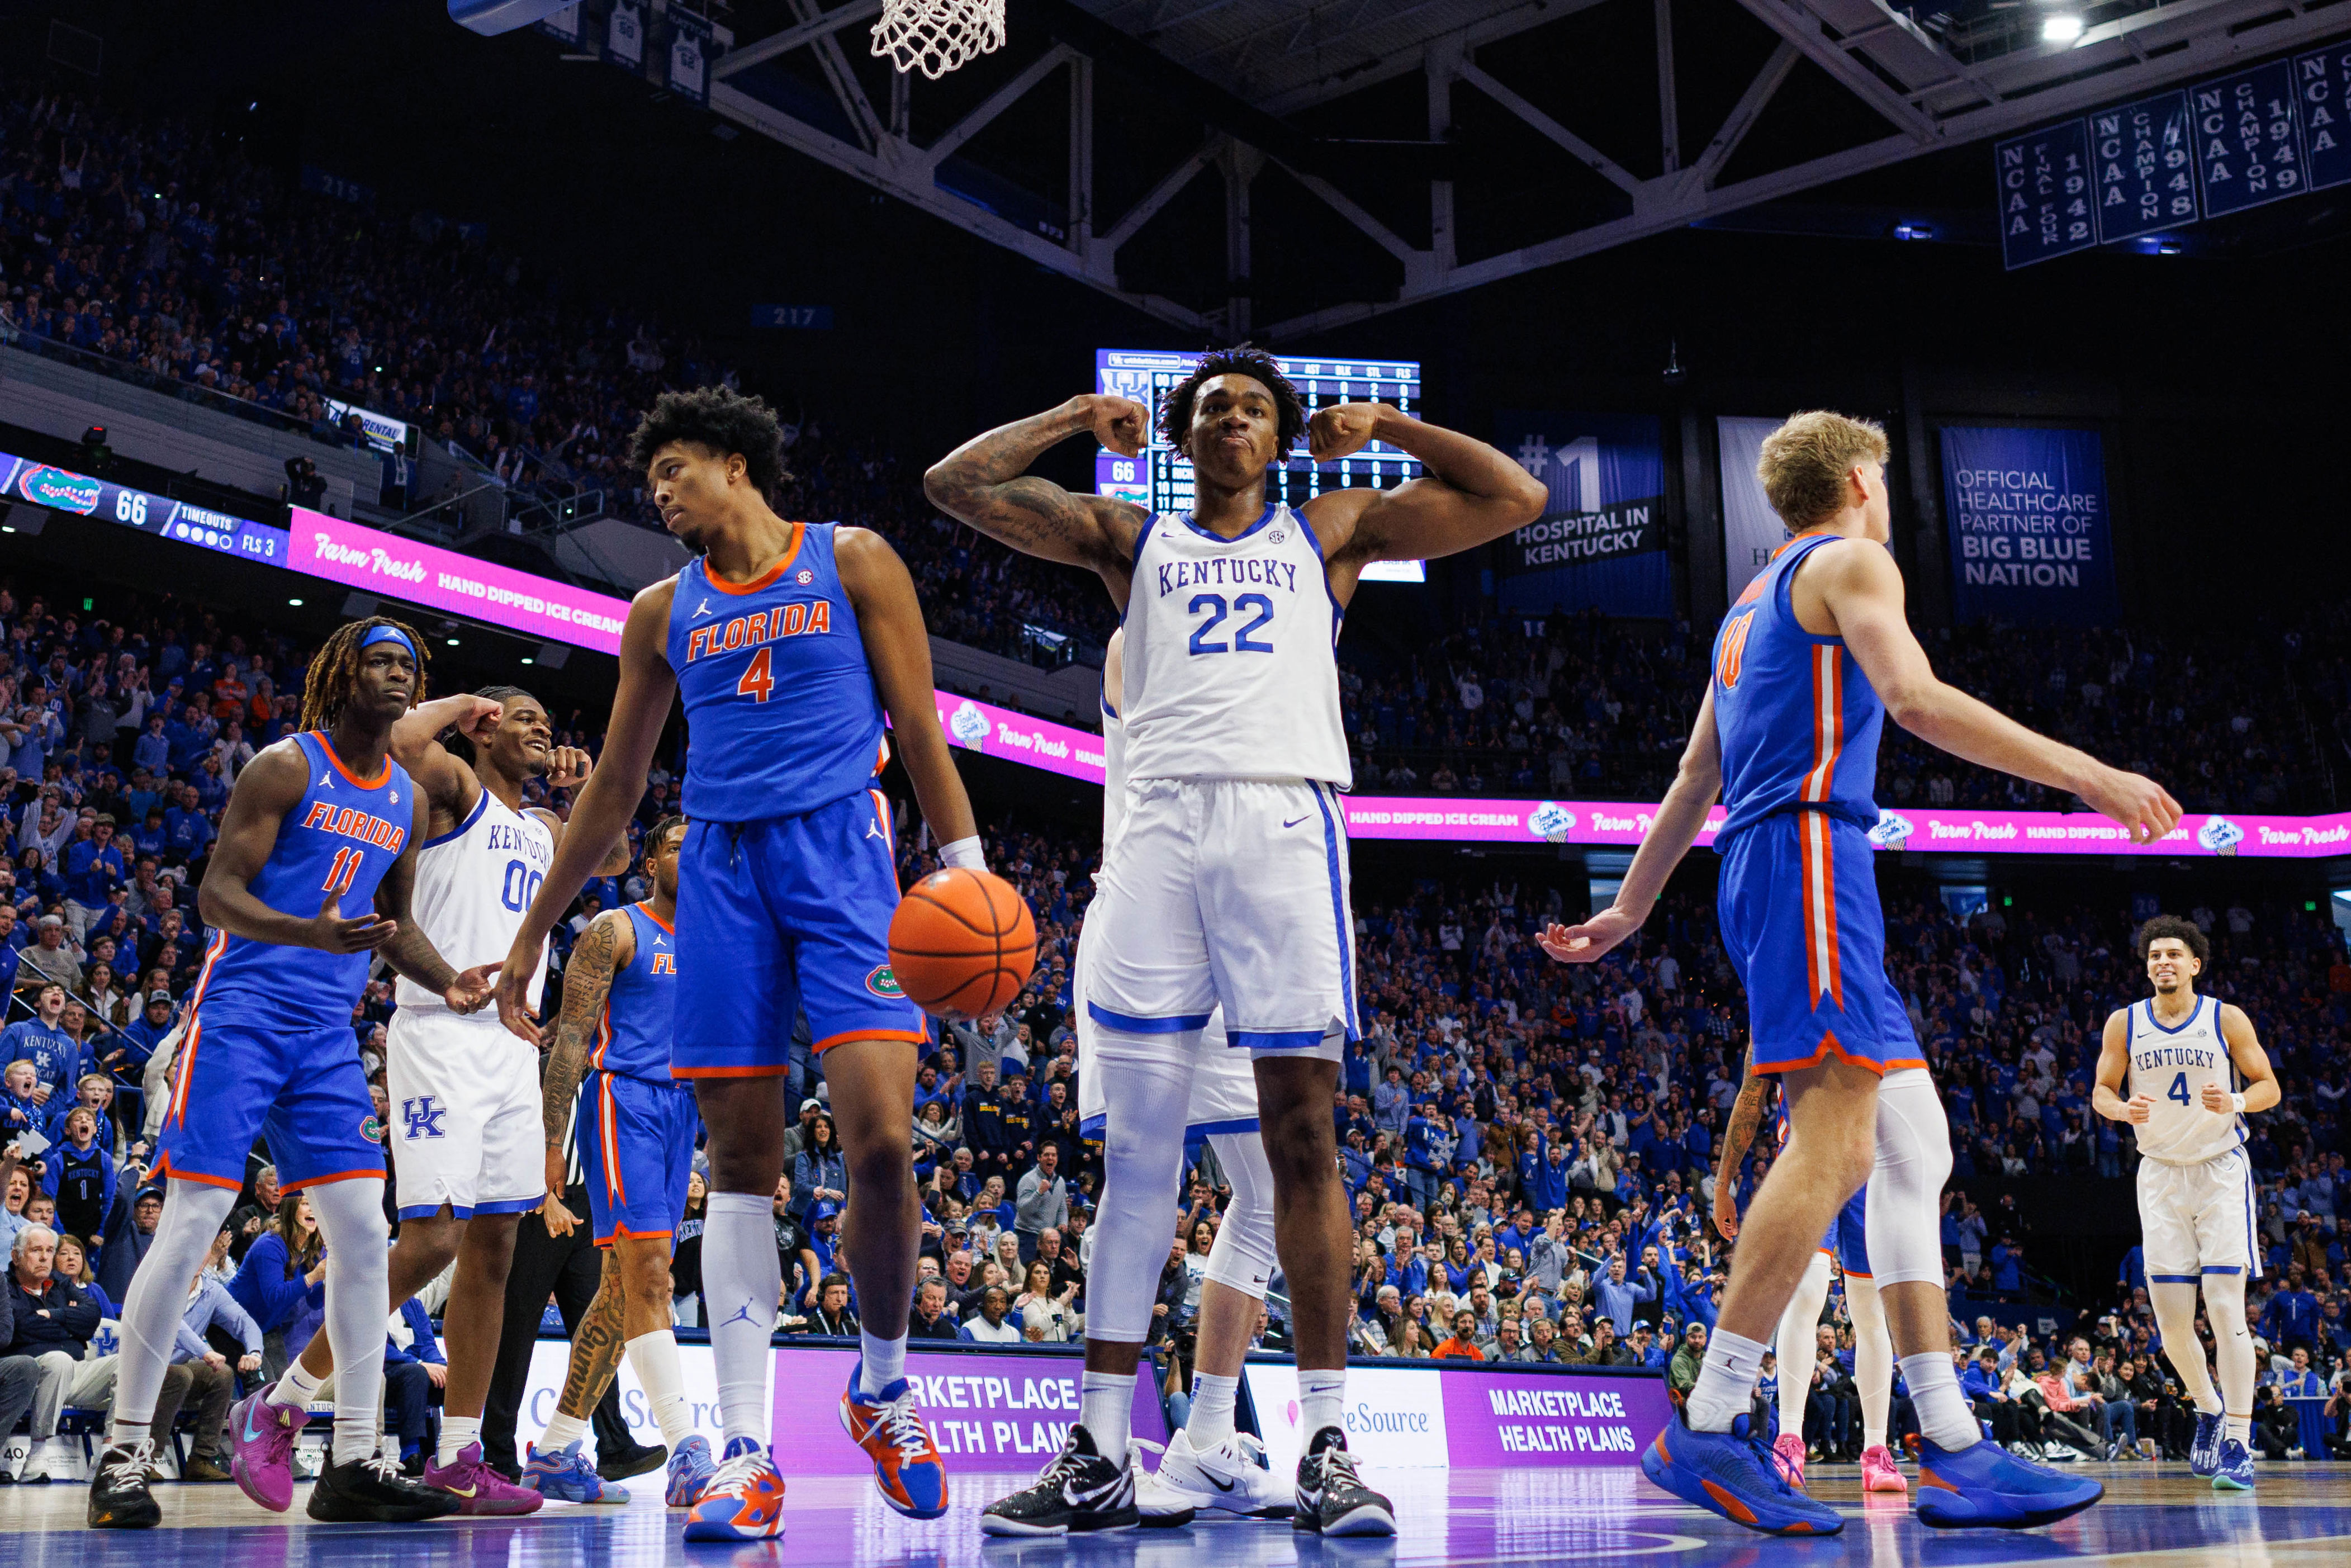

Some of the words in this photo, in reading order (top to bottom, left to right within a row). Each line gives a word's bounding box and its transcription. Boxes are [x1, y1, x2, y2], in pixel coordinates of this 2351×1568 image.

[2302, 55, 2337, 152] NCAA
[2198, 88, 2232, 183] NCAA
[2235, 83, 2267, 193] CHAMPION
[2268, 98, 2297, 189] 1949
[2035, 143, 2053, 195] FINAL
[2098, 114, 2126, 207] NCAA
[2133, 112, 2159, 220] CHAMPION
[2002, 144, 2030, 235] NCAA
[2065, 152, 2088, 241] 1942
[2040, 202, 2059, 246] FOUR
[774, 308, 815, 325] 217
[1155, 373, 1169, 387] 00
[1304, 363, 1320, 375] AST
[1335, 365, 1352, 376] BLK
[1366, 367, 1381, 378] STL
[1395, 368, 1411, 379] FLS
[1308, 380, 1317, 394] 0
[1339, 381, 1349, 395] 0
[1370, 382, 1378, 396] 2
[1399, 384, 1409, 397] 0
[1309, 394, 1317, 406] 5
[1399, 397, 1409, 411] 2
[362, 419, 397, 439] RENTAL
[1371, 439, 1381, 452] 0
[1158, 452, 1167, 466] 4
[1342, 459, 1350, 473] 0
[1372, 461, 1381, 475] 0
[1402, 462, 1411, 476] 0
[1112, 462, 1135, 482] 66
[1158, 466, 1167, 480] 5
[1172, 467, 1195, 480] RICH
[1278, 471, 1288, 485] 5
[1310, 472, 1319, 486] 2
[1342, 473, 1350, 487] 0
[1372, 475, 1381, 489] 0
[1518, 434, 1601, 512] #1
[1957, 470, 2055, 490] OFFICIAL
[1156, 481, 1170, 495] 10
[1280, 486, 1287, 500] 1
[116, 490, 148, 525] 66
[1156, 496, 1170, 509] 11
[1959, 492, 2098, 513] HEALTHCARE
[182, 505, 232, 531] TIMEOUTS
[1516, 512, 1622, 544] HOSPITAL
[1626, 506, 1649, 527] IN
[1961, 513, 2056, 533] PARTNER
[2063, 515, 2092, 534] OF
[242, 534, 262, 553] FLS
[265, 538, 274, 557] 3
[1269, 531, 1284, 543] SEC
[1525, 529, 1642, 566] KENTUCKY
[1963, 536, 2011, 560] BIG
[2021, 537, 2092, 560] BLUE
[315, 533, 370, 568] Farm
[371, 548, 427, 583] Fresh
[438, 572, 486, 598] HAND
[487, 585, 545, 614] DIPPED
[546, 601, 571, 622] ICE
[571, 609, 624, 636] CREAM
[798, 571, 813, 584] SEC
[1159, 558, 1296, 598] KENTUCKY
[1966, 562, 2079, 586] NATION
[686, 601, 830, 663] FLORIDA
[1188, 593, 1274, 656] 22
[737, 646, 775, 704] 4
[998, 723, 1033, 749] Farm
[1034, 732, 1069, 759] Fresh
[1075, 750, 1106, 768] HAND
[300, 801, 405, 854] FLORIDA
[1350, 812, 1391, 824] HAND
[1393, 813, 1443, 825] DIPPED
[1445, 813, 1468, 825] ICE
[1469, 814, 1518, 826] CREAM
[1591, 813, 1636, 831] Farm
[1928, 821, 1971, 839] Farm
[1971, 822, 2018, 840] Fresh
[2027, 827, 2066, 839] HAND
[2071, 827, 2117, 840] DIPPED
[2259, 826, 2300, 845] Farm
[2302, 825, 2349, 846] Fresh
[321, 846, 364, 895] 11
[501, 859, 543, 913] 00
[23, 1035, 67, 1058] KENTUCKY
[2135, 1048, 2214, 1071] KENTUCKY
[2167, 1072, 2191, 1106] 4
[402, 1096, 446, 1140] UK
[68, 1168, 99, 1181] KENTUCKY
[80, 1179, 87, 1200] 1
[904, 1375, 1080, 1410] RKETPLACE
[1489, 1390, 1626, 1418] MARKETPLACE
[1342, 1403, 1429, 1433] eSource
[928, 1420, 986, 1453] LTH
[1499, 1425, 1575, 1452] HEALTH
[1577, 1425, 1636, 1453] PLANS
[4, 1447, 23, 1461] 40
